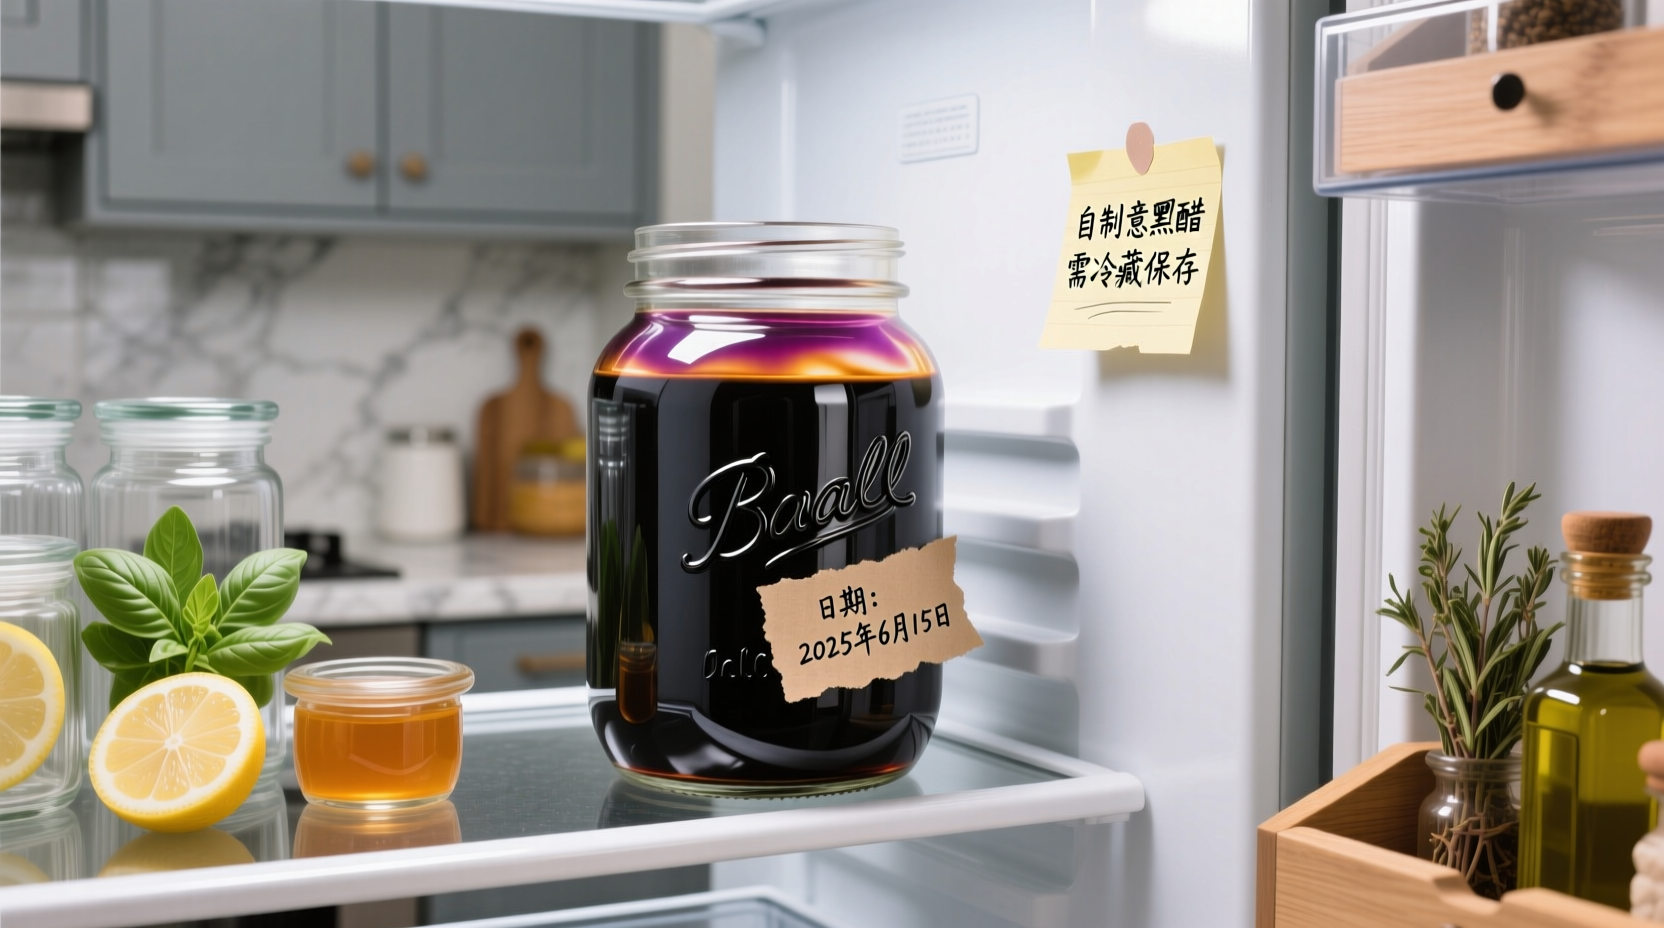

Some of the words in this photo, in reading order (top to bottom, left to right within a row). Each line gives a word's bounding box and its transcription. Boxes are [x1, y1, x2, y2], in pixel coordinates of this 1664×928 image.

[1067, 248, 1199, 289] 需冷藏保存
[798, 603, 951, 665] 2025年6月15日
